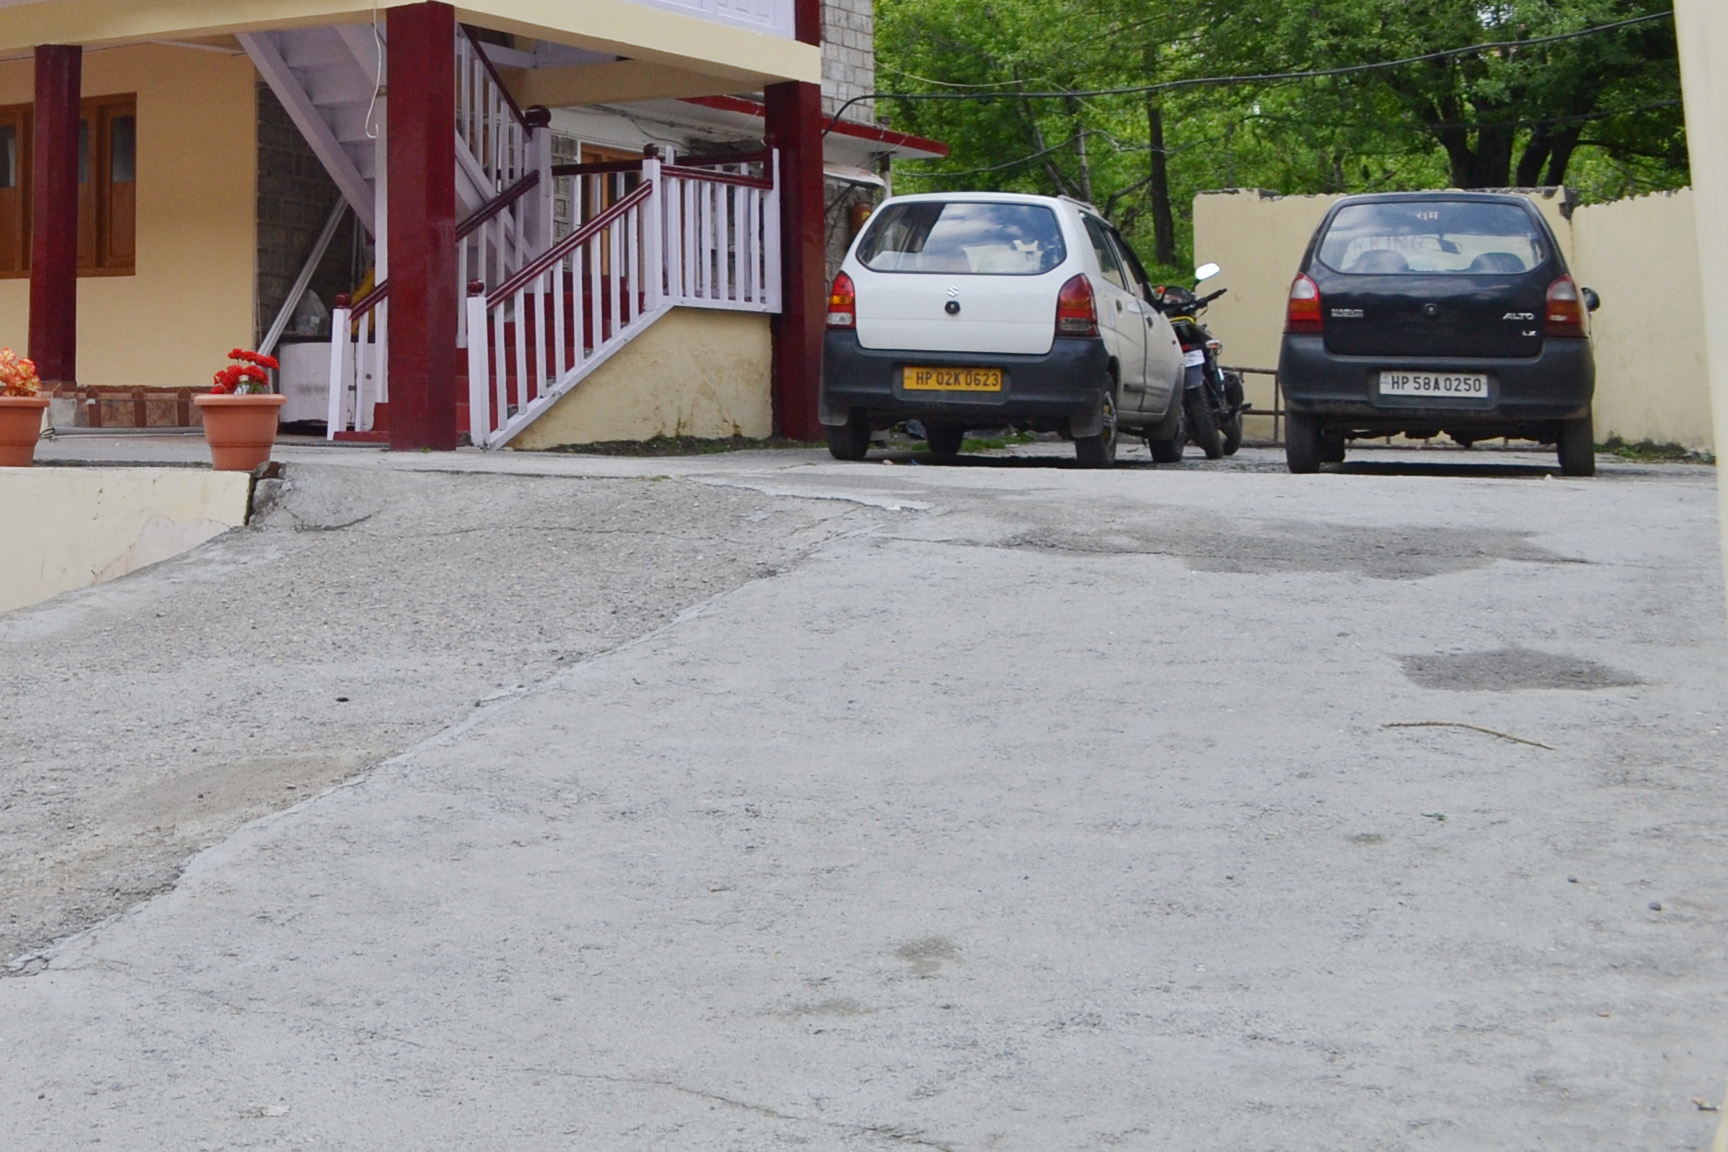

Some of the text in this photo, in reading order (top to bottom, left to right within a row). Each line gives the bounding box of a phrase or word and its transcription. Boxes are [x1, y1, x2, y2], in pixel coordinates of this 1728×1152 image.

[1502, 312, 1535, 320] ALTO
[916, 371, 999, 387] HP 02K 0623
[1391, 375, 1482, 392] HP 58A 0250
